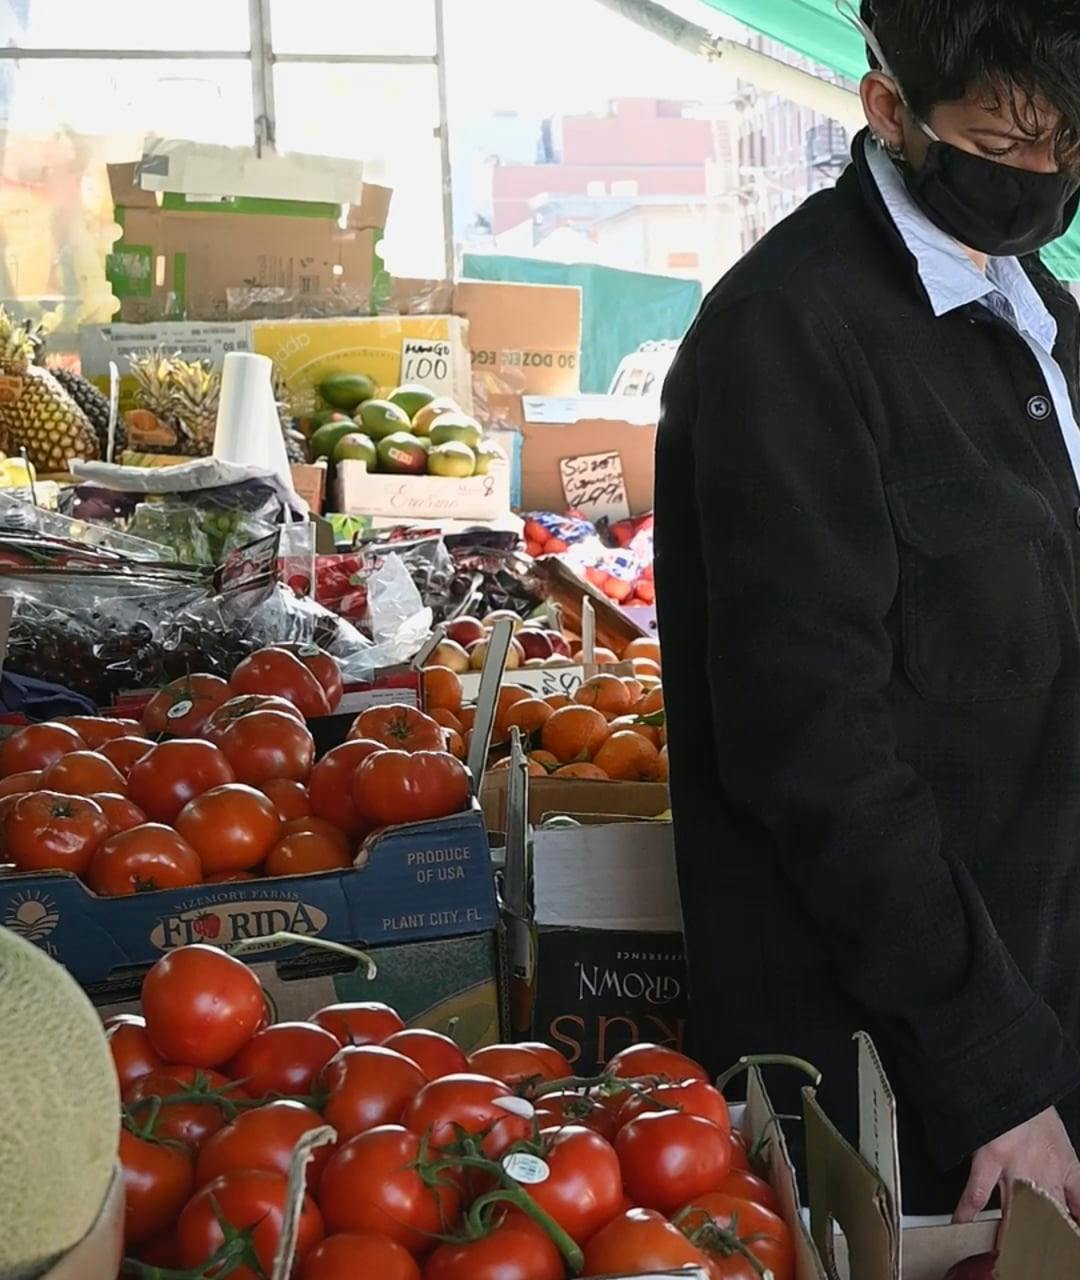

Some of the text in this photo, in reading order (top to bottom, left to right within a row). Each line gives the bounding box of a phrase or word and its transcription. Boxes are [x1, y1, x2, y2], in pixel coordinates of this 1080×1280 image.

[404, 358, 448, 381] 1.00
[557, 354, 576, 369] 30
[407, 846, 471, 865] PRODUCE
[416, 865, 465, 884] OF USA
[173, 889, 300, 911] SIZEMORE FARMS
[383, 913, 425, 930] PLANT
[466, 907, 482, 923] FL
[578, 963, 681, 1005] GROWN
